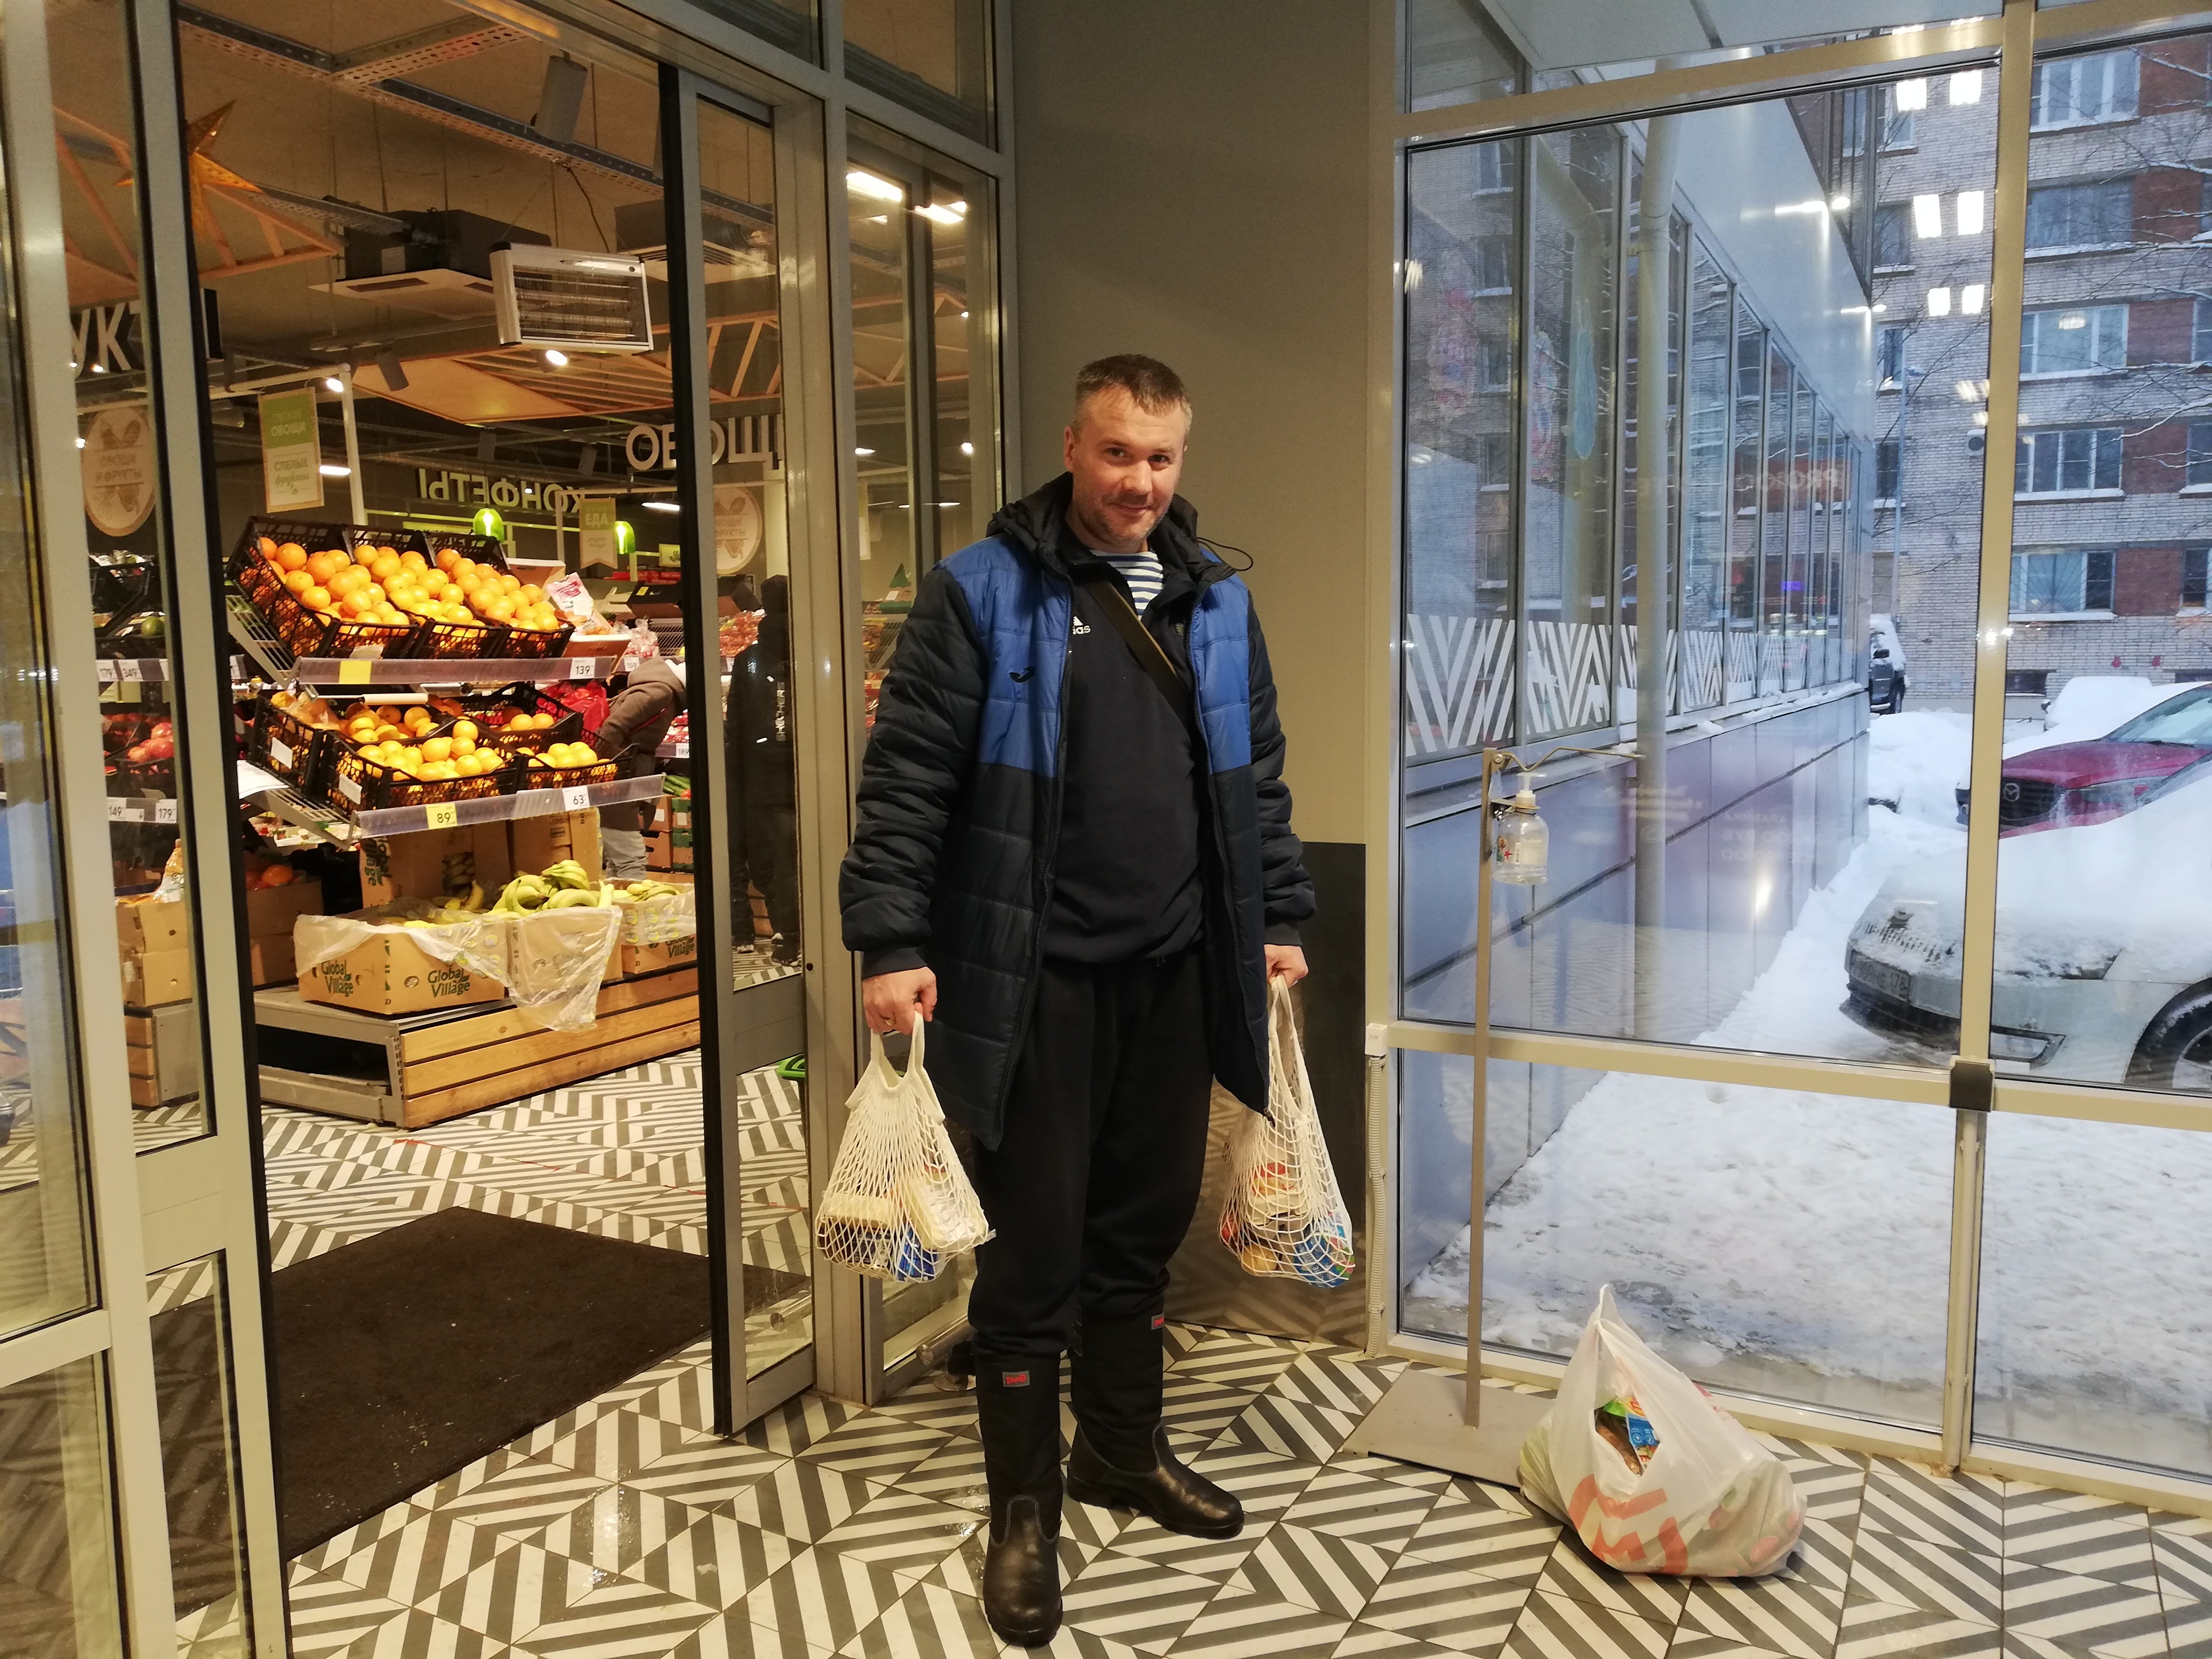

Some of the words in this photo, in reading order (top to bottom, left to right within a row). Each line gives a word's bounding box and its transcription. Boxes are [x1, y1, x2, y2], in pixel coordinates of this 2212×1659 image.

[270, 421, 306, 437] ОВОЩИ
[625, 414, 783, 470] ОВЩ
[274, 457, 308, 471] СПЕЛЫЕ
[585, 513, 609, 527] ЕДА
[714, 518, 741, 527] ВОЩИ
[576, 665, 590, 675] 139
[573, 794, 584, 805] 63
[108, 805, 122, 817] 149
[158, 808, 172, 819] 179
[437, 812, 451, 823] 89
[668, 942, 695, 958] Village
[321, 960, 347, 975] Global
[428, 967, 464, 984] Global
[324, 975, 354, 997] Village
[431, 981, 470, 998] Village
